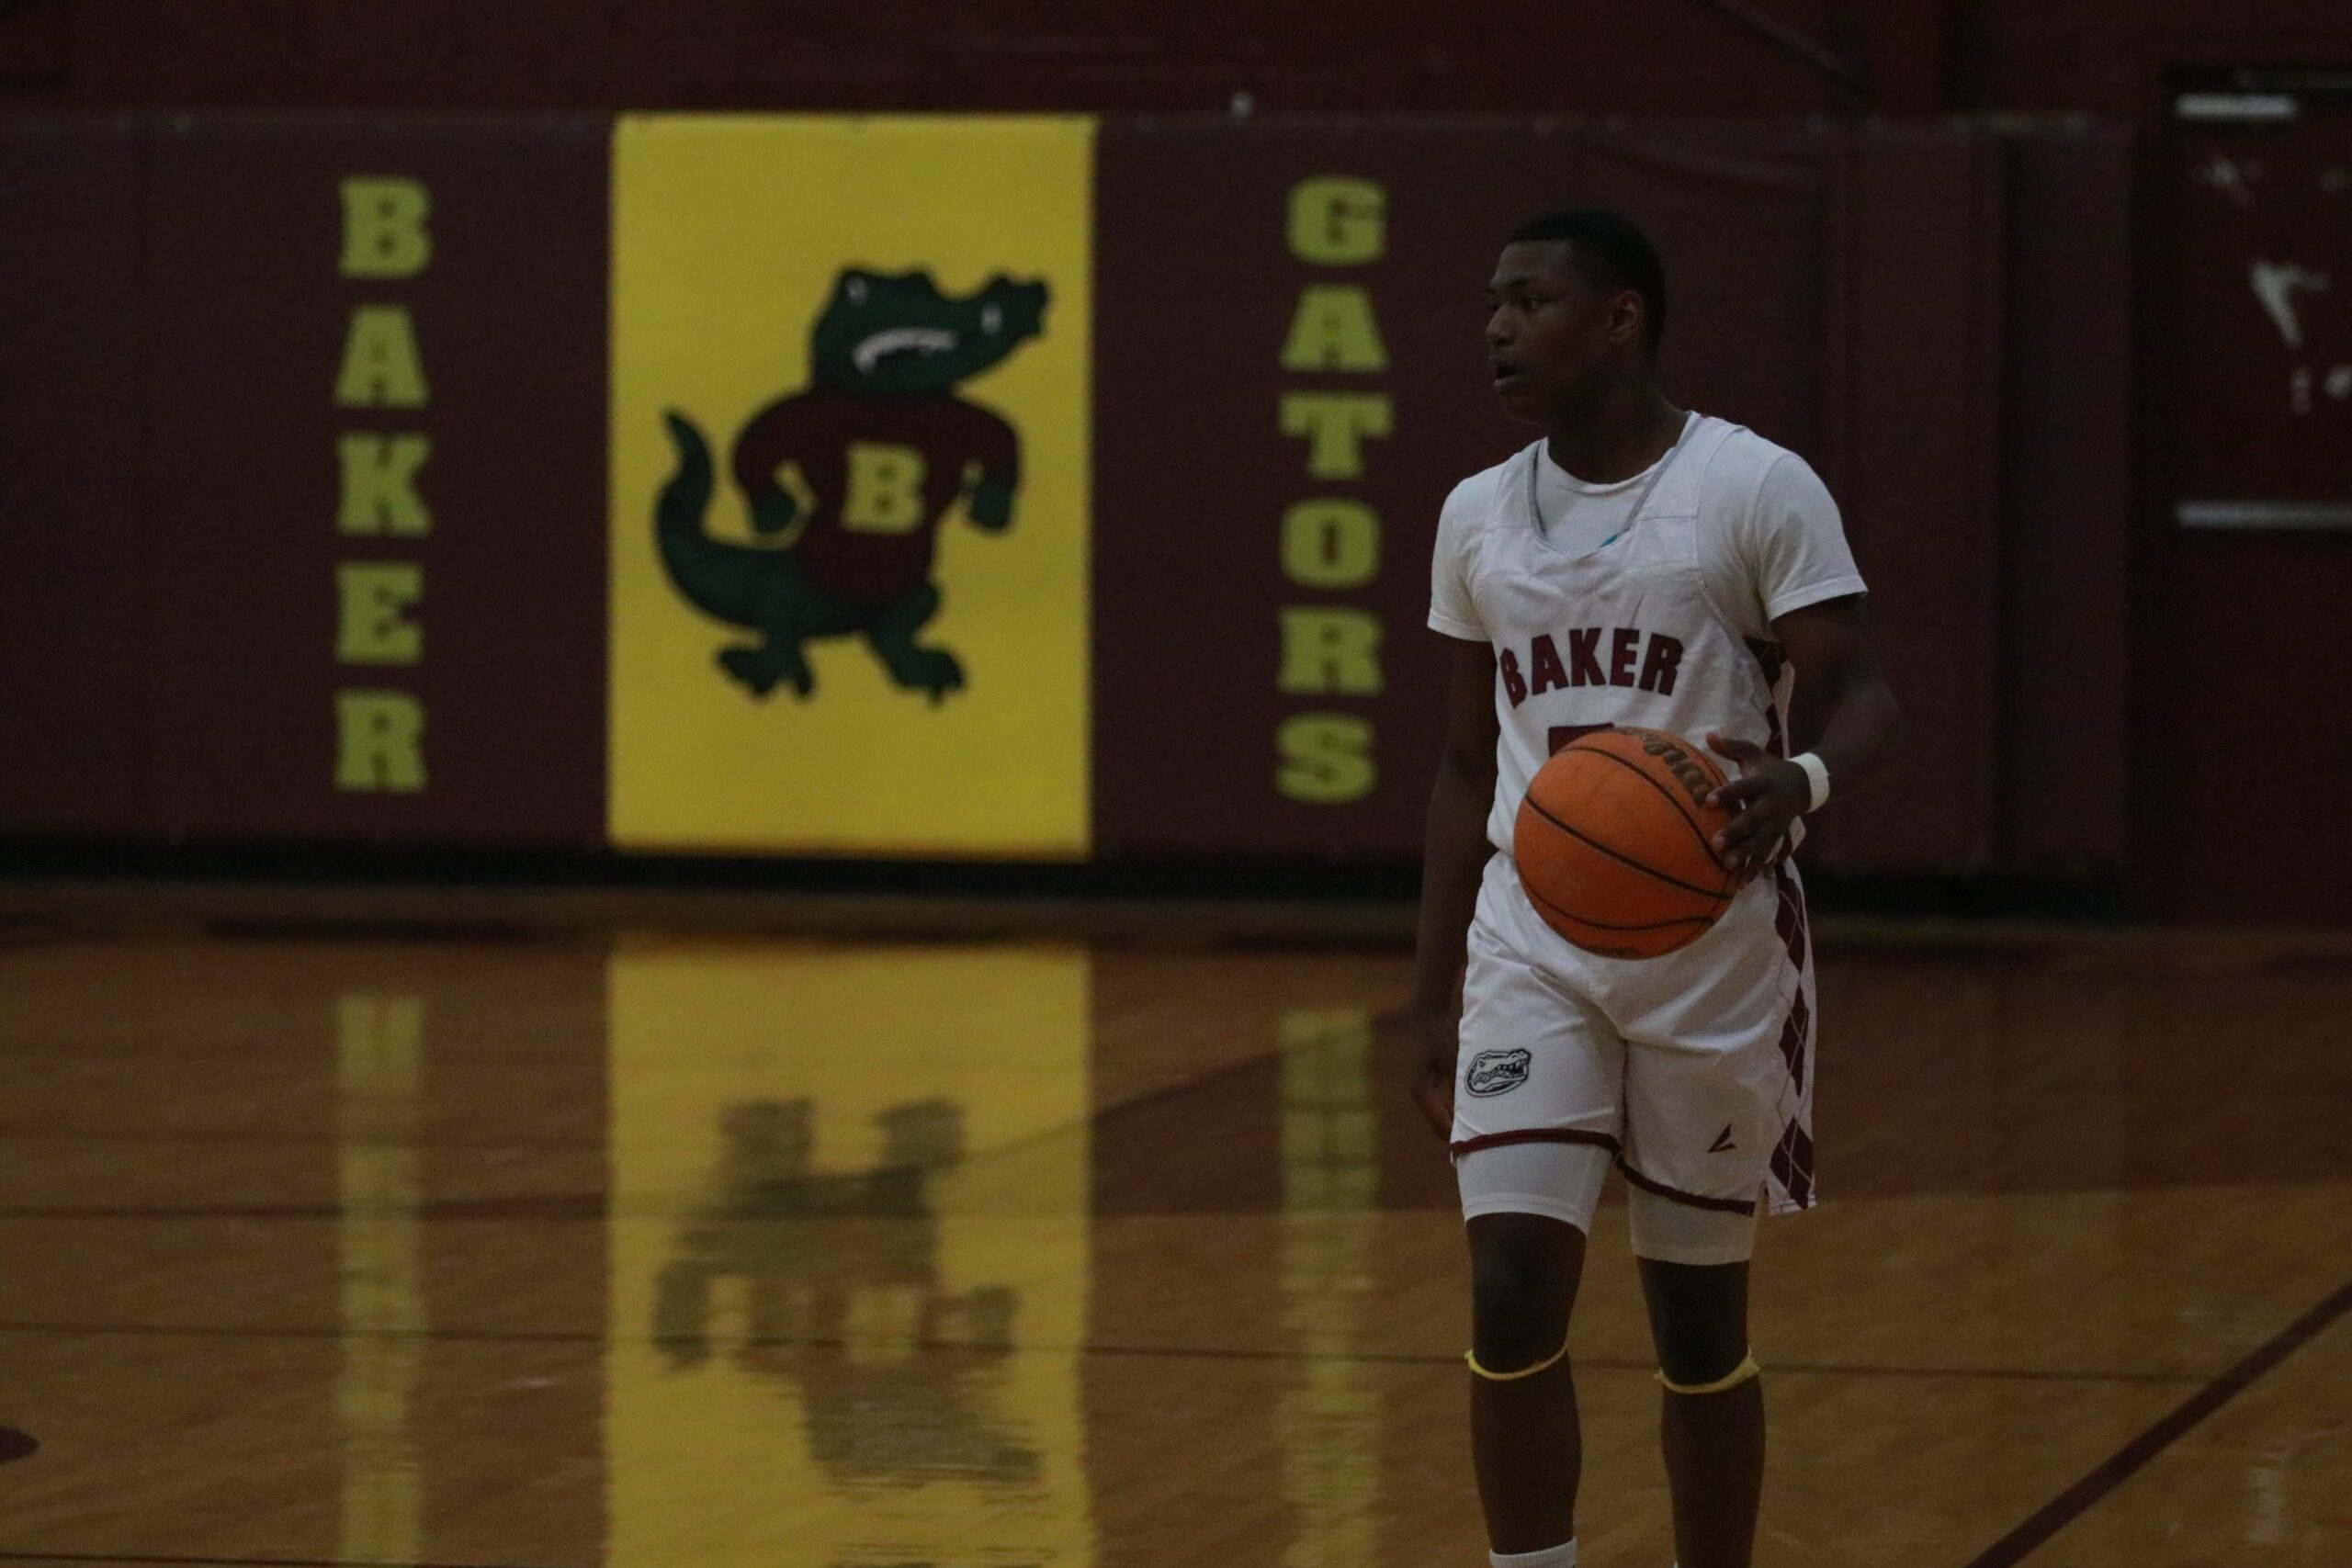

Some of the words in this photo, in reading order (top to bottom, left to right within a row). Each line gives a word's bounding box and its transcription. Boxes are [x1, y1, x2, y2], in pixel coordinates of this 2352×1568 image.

[334, 175, 434, 793] BAKER
[841, 440, 930, 533] B
[1276, 176, 1395, 804] GATORS
[1499, 627, 1684, 710] BAKER
